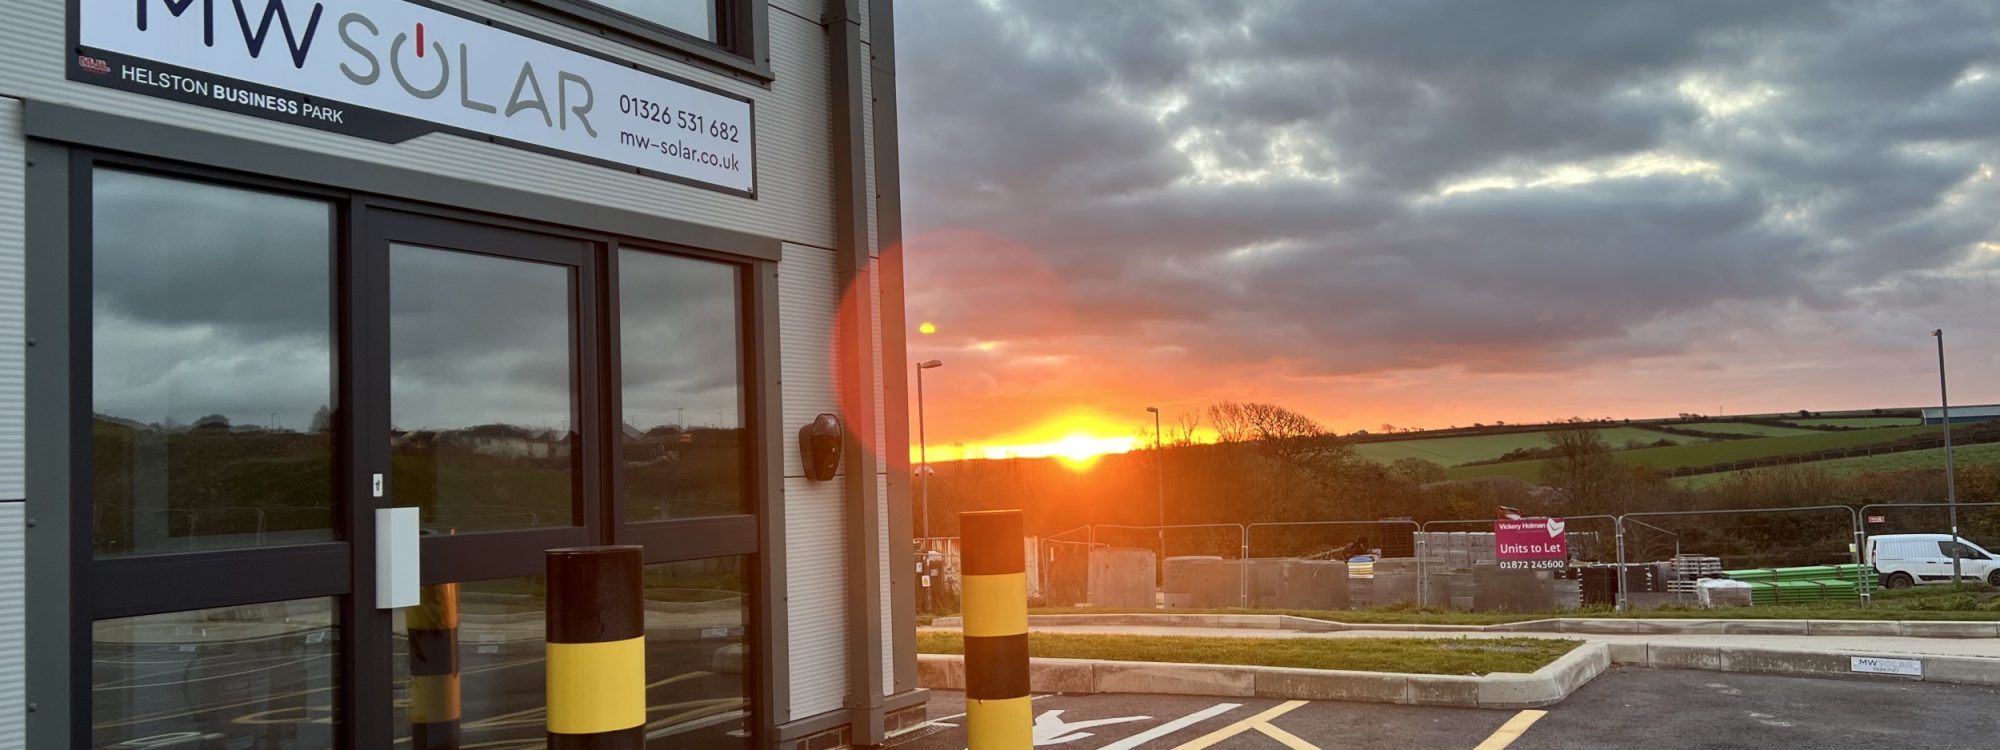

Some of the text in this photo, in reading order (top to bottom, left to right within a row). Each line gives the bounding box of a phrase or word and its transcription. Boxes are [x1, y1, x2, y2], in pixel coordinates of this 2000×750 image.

[121, 64, 344, 125] HELSTON BUSINESS PARK
[619, 94, 739, 143] 01326 531 682
[619, 128, 740, 172] mw-solar.co.uk
[1500, 542, 1562, 554] Units to Let
[1500, 560, 1564, 569] 01872 245600
